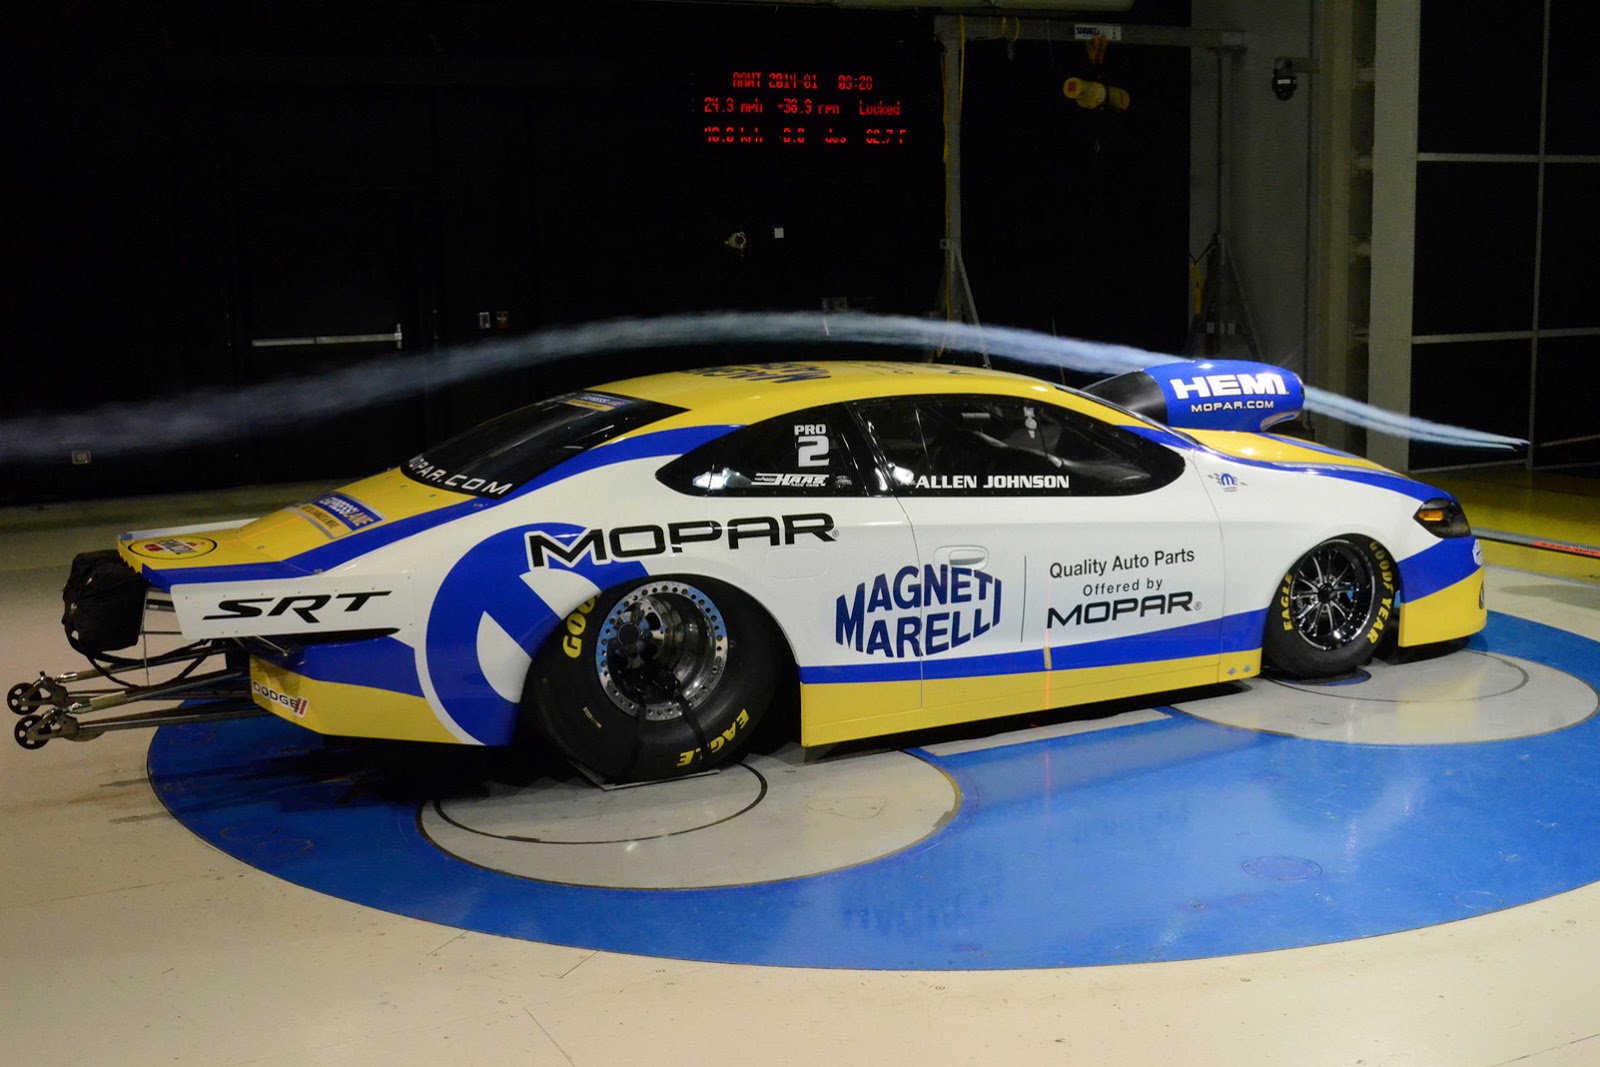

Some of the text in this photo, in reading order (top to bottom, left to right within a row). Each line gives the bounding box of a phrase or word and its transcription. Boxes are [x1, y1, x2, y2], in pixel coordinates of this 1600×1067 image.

[859, 99, 901, 116] Locked
[1170, 374, 1286, 399] HEMI
[1191, 400, 1274, 413] MOPAR.COM
[794, 424, 827, 436] PRO
[798, 435, 830, 468] 2
[915, 475, 1070, 489] ALLEN JOHNSON
[528, 513, 838, 568] MOPAR
[1049, 548, 1195, 579] Quality Auto Parts
[1082, 577, 1164, 597] Offered by
[202, 590, 392, 624] SRT
[1046, 591, 1194, 629] MOPAR
[1280, 574, 1294, 632] EAGLE
[253, 681, 299, 710] DODGE
